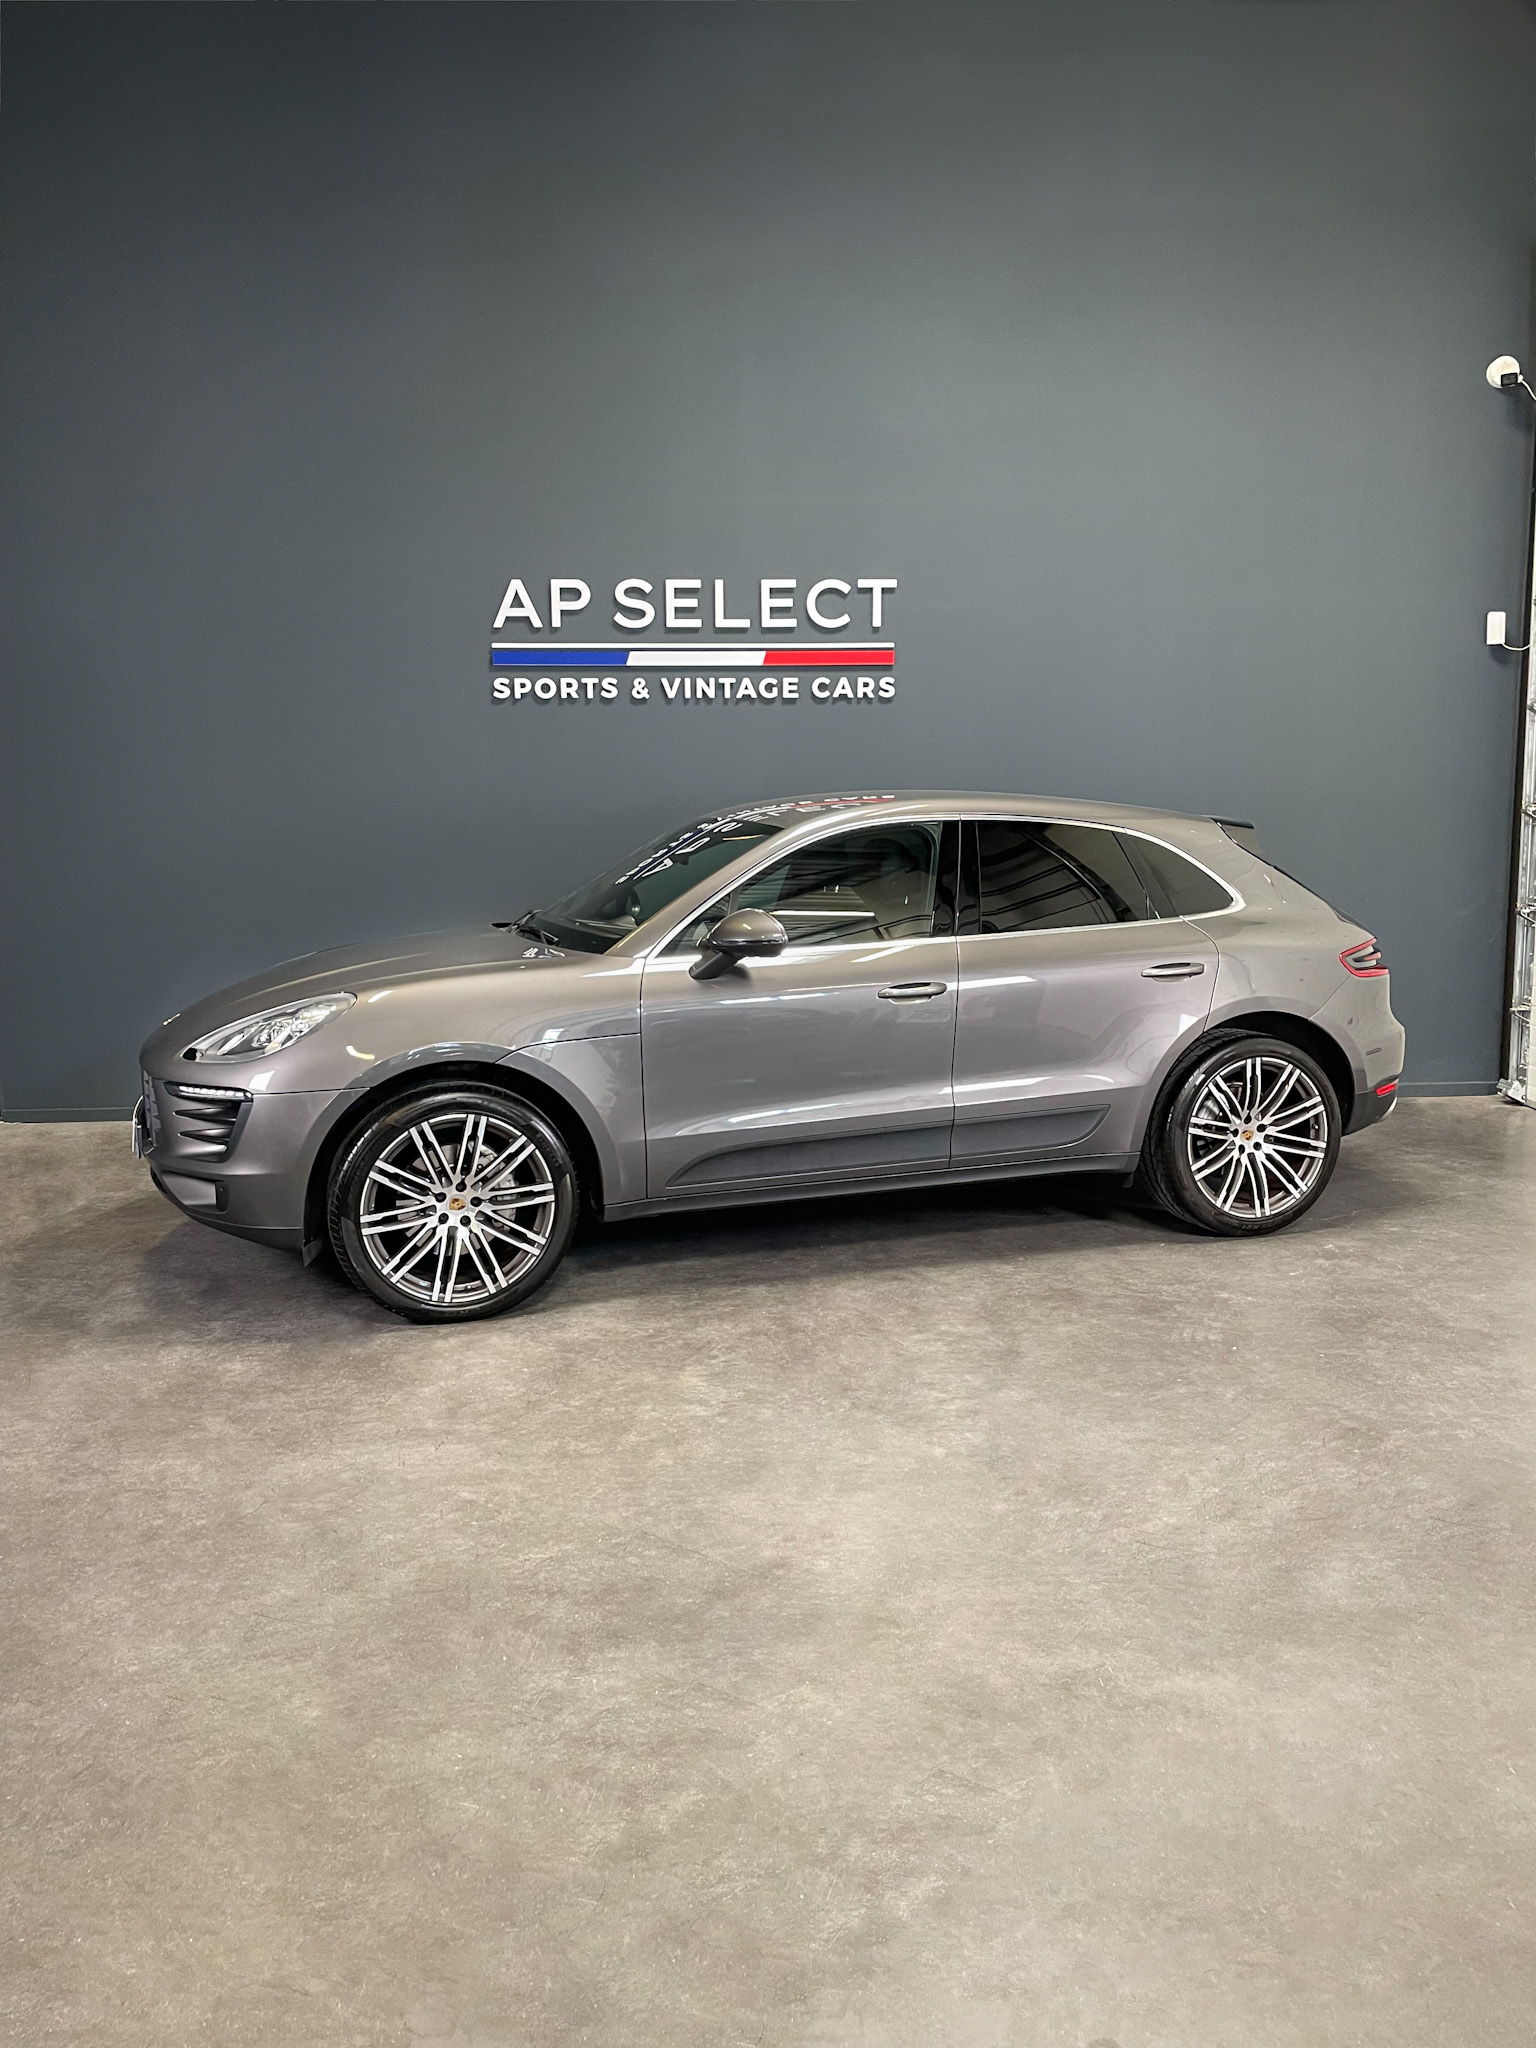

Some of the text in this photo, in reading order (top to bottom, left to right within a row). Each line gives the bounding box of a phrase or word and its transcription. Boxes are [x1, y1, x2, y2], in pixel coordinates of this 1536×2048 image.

[492, 578, 898, 629] AP SELECT
[493, 676, 896, 699] SPORTS & VINTAGE CARS
